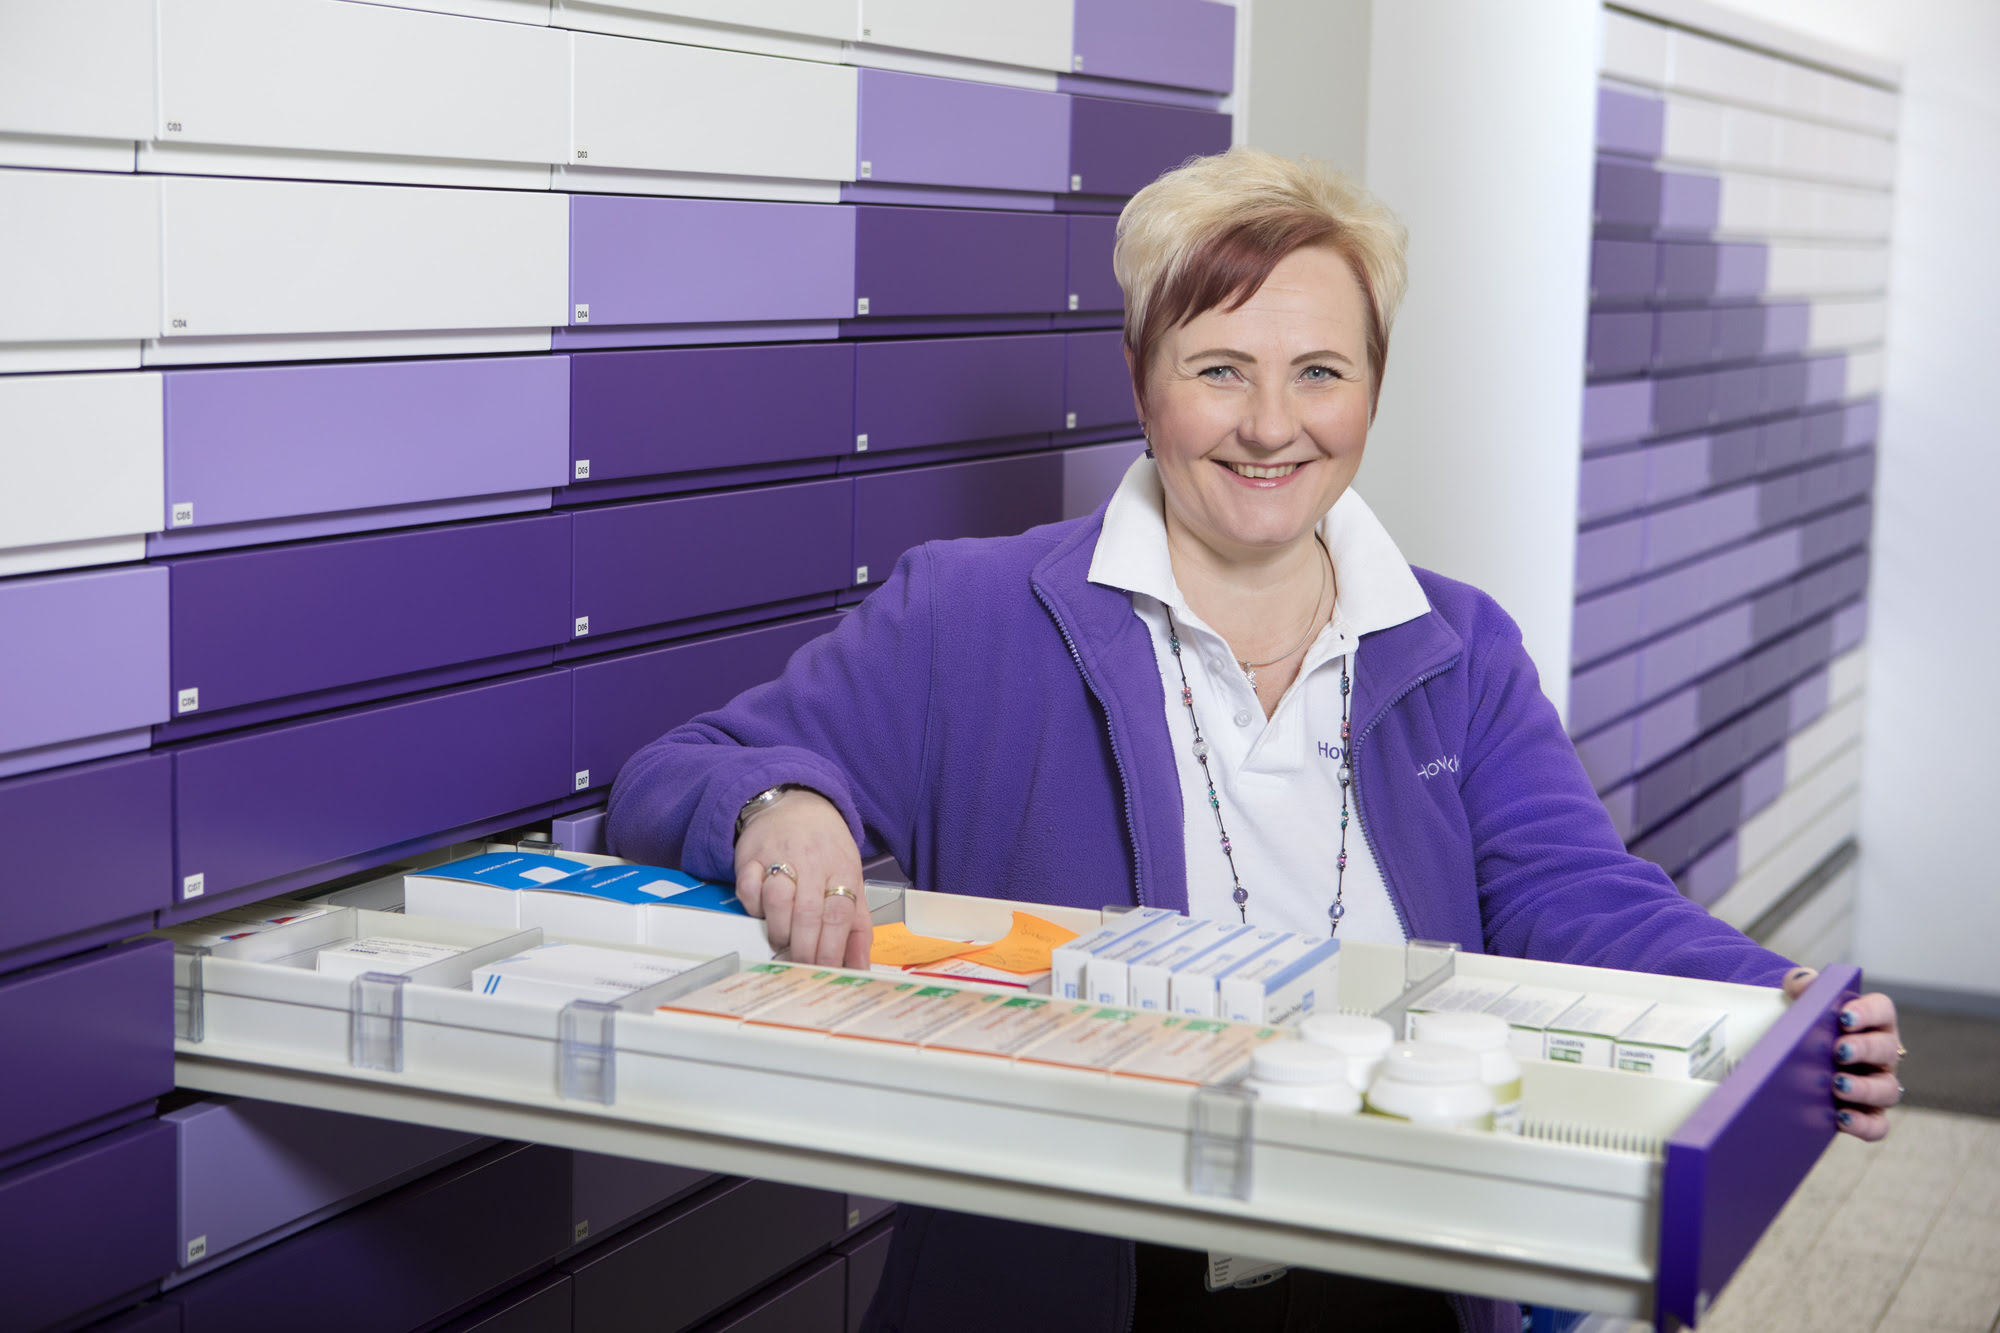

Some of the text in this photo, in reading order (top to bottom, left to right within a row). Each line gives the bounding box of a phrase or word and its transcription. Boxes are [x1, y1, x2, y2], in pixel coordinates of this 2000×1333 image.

[167, 122, 182, 133] C03
[577, 151, 588, 159] D03
[577, 310, 588, 319] D04
[172, 319, 187, 329] C04
[577, 466, 588, 475] D05
[176, 511, 191, 521] C05
[577, 623, 588, 632] D06
[182, 697, 196, 707] C06
[577, 776, 588, 785] D07
[187, 882, 201, 893] C07
